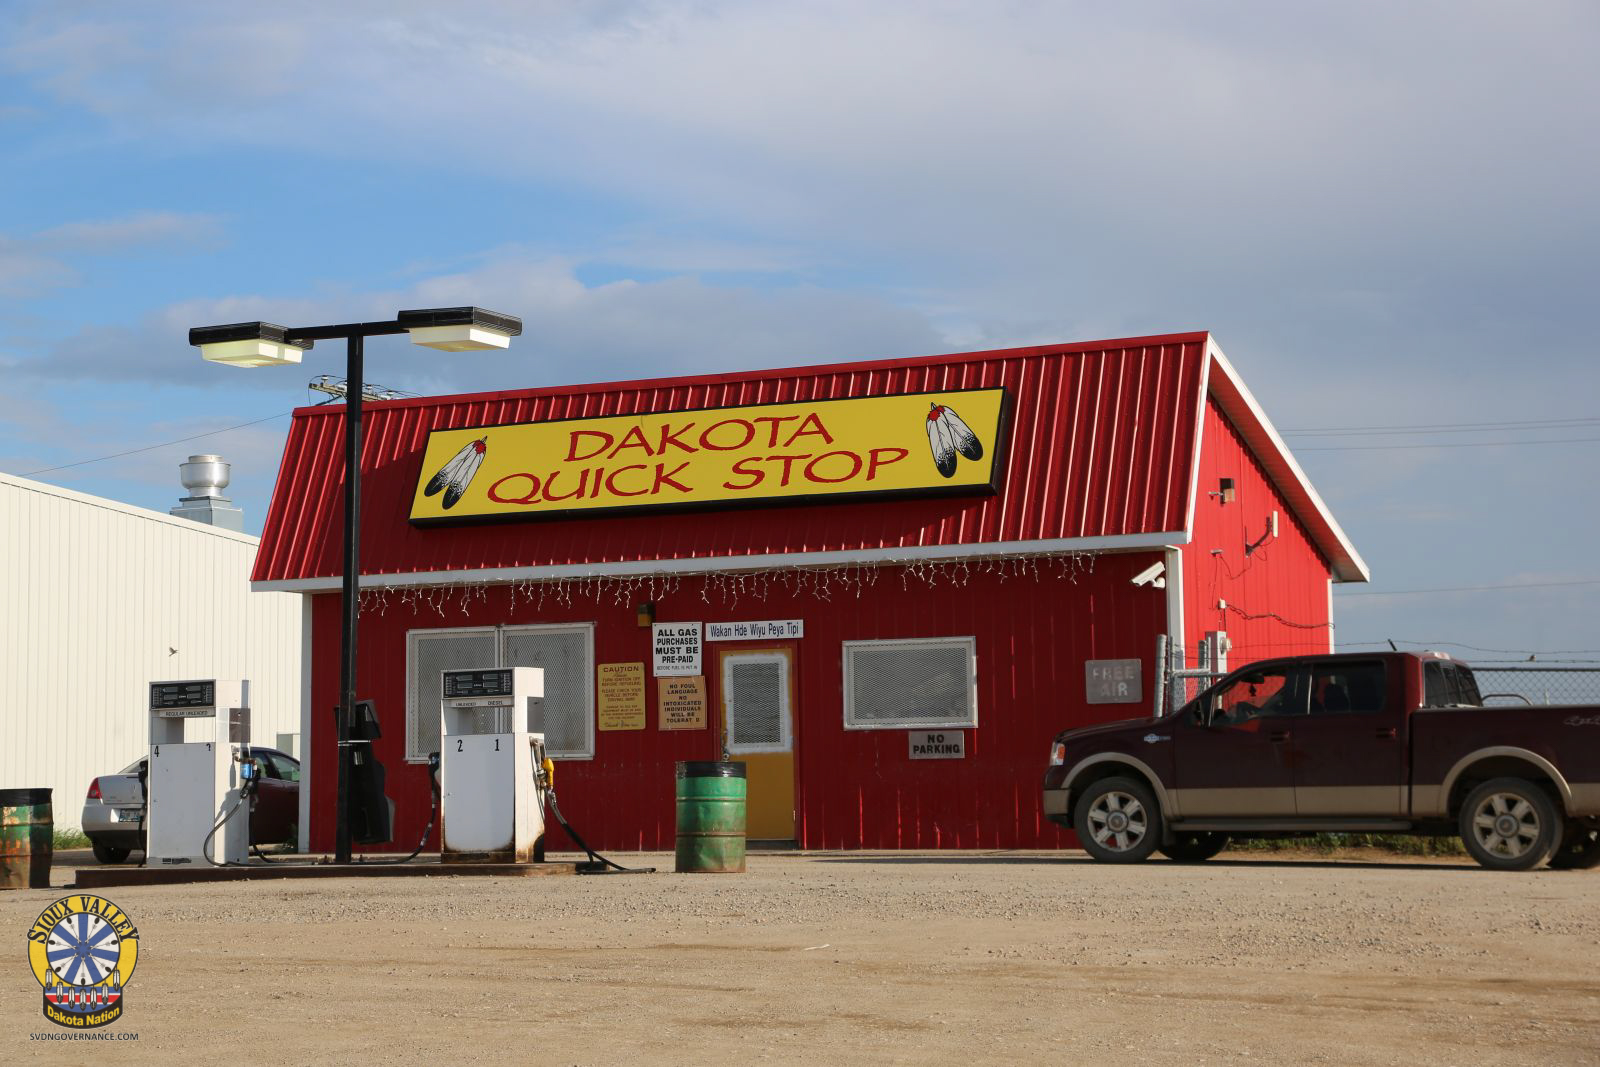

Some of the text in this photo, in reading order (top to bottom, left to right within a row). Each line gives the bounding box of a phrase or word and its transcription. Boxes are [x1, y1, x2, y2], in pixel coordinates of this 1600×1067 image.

[564, 412, 834, 462] DAKOTA
[487, 447, 909, 505] QUICK STOP
[657, 628, 698, 637] ALL GAS
[710, 621, 799, 638] Wakan Hde Wiyu Peya Tipi
[656, 637, 698, 646] PURCHASES
[655, 646, 699, 655] MUST BE
[603, 665, 640, 673] CAUTION
[1092, 665, 1136, 681] FREE
[1100, 681, 1128, 697] AIR
[457, 738, 500, 753] 2 1
[927, 734, 945, 744] NO
[153, 745, 160, 758] 4
[912, 743, 961, 754] PARKING
